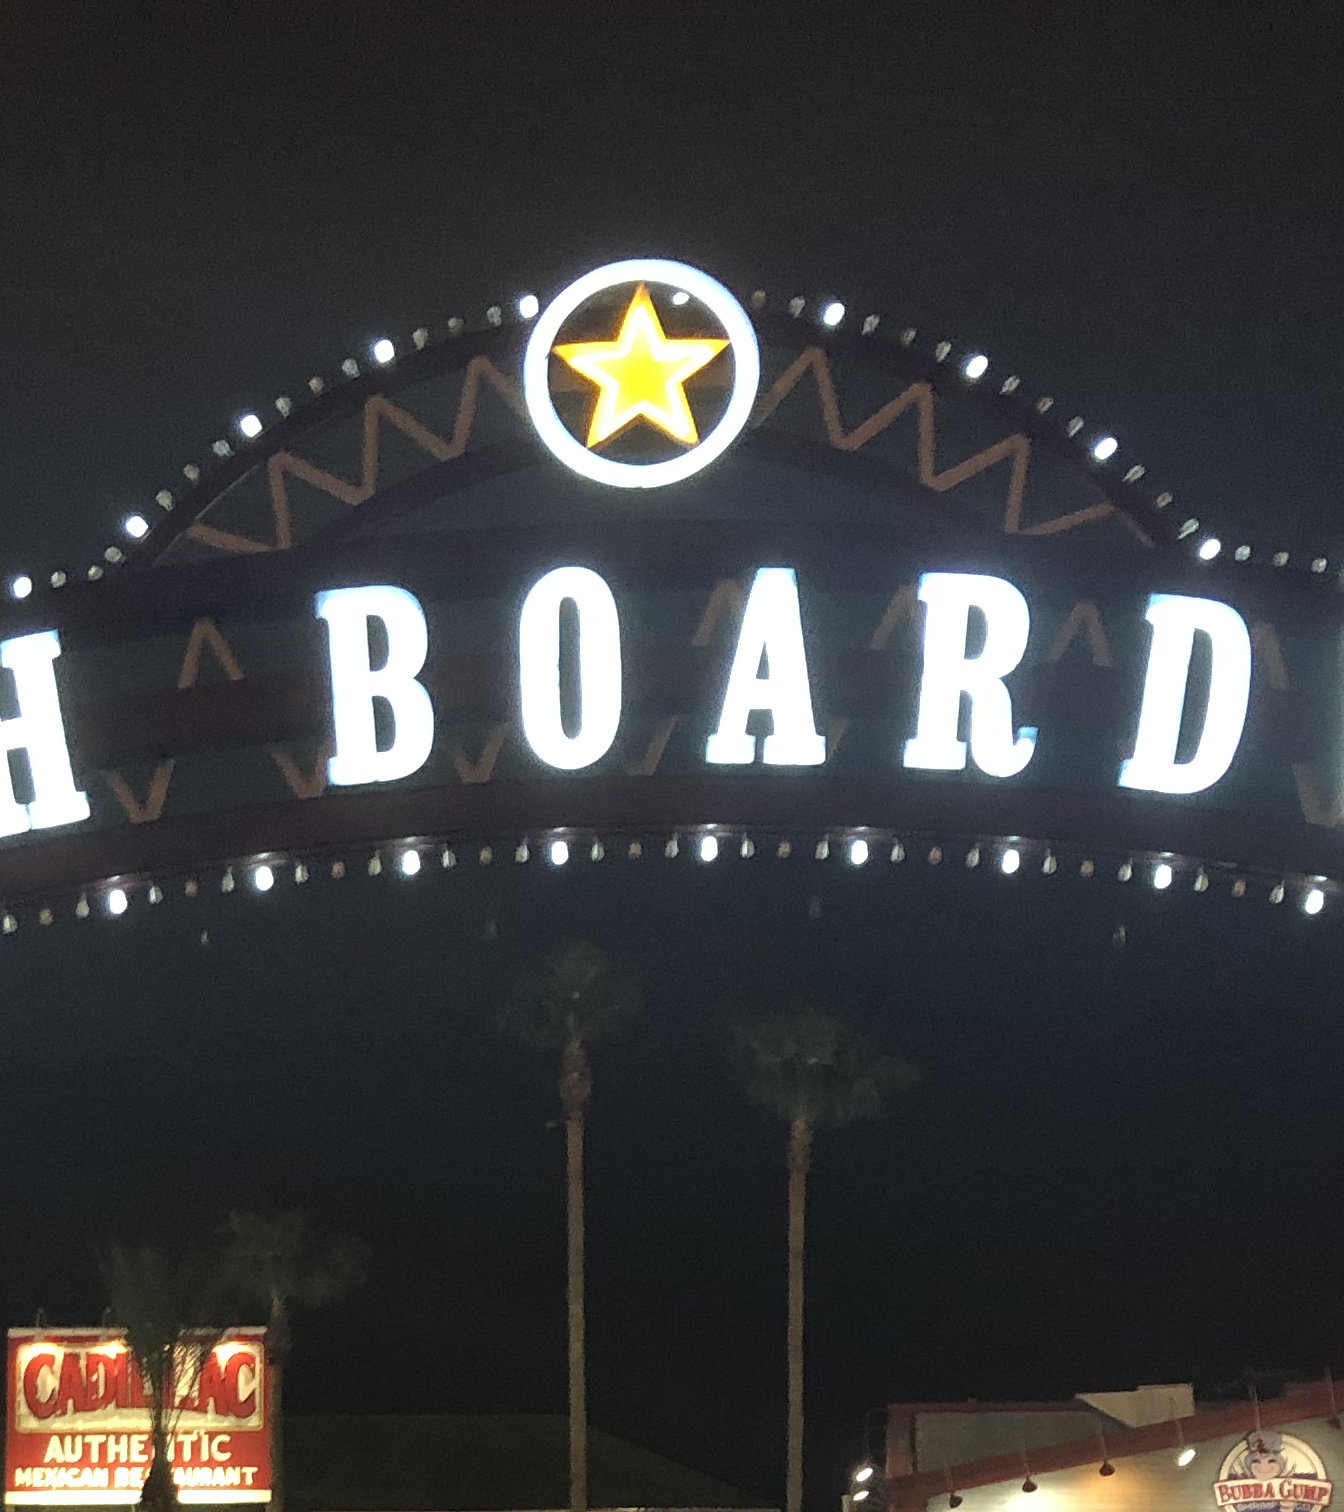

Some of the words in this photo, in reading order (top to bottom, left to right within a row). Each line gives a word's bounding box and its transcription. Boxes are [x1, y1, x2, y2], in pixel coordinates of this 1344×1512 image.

[15, 1467, 109, 1488] MEXICAN
[114, 1466, 258, 1488] REAURANT
[1218, 1481, 1275, 1502] BUBBA
[1279, 1479, 1328, 1502] GUMP
